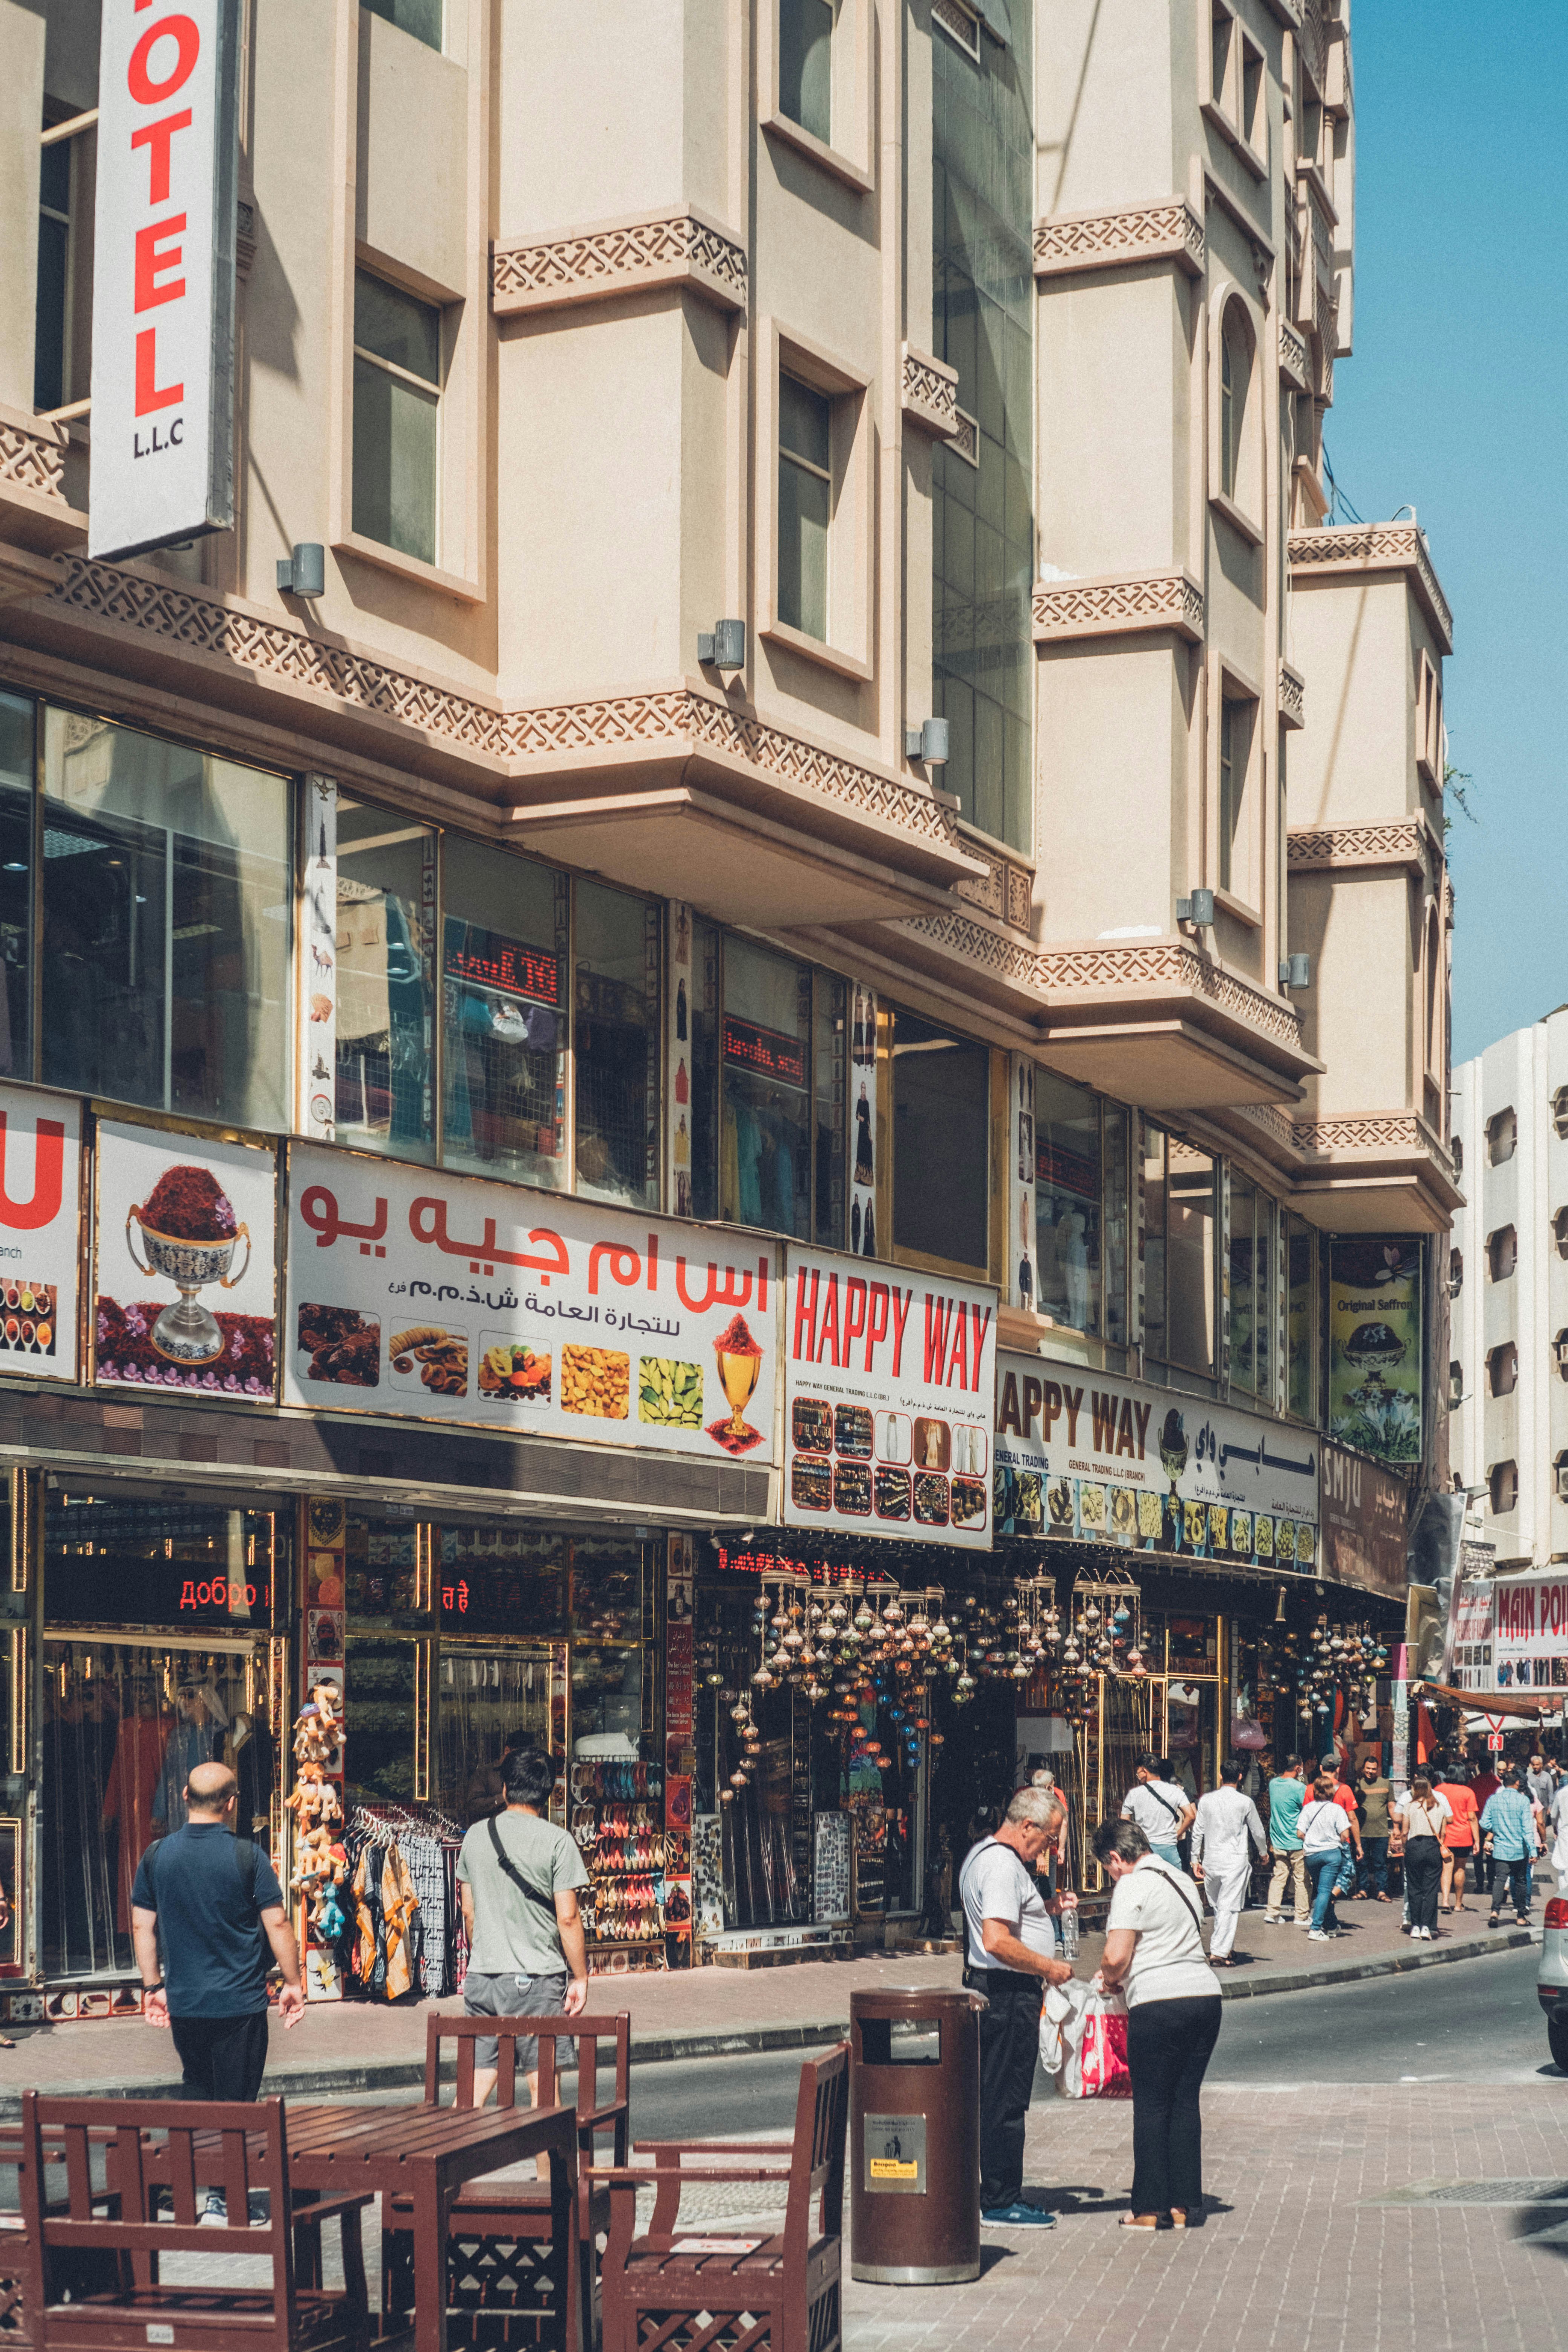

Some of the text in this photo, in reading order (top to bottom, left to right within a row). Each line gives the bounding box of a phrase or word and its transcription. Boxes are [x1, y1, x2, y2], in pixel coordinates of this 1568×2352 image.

[127, 0, 201, 418] OTEL
[133, 418, 184, 460] L.L.C
[388, 1281, 406, 1294] فرع
[525, 1292, 599, 1323] العامة
[1337, 1298, 1413, 1314] Original Saffron
[605, 1308, 680, 1337] للتجارة
[792, 1265, 992, 1393] HAPPY WAY
[795, 1380, 811, 1388] HAPPY
[824, 1384, 845, 1394] GENERAL
[846, 1388, 865, 1397] TRADING
[934, 1404, 947, 1412] العامة
[949, 1407, 965, 1415] للتجارة
[1091, 1390, 1152, 1461] WAY
[994, 1449, 1049, 1470] ENERAL TRADING
[1069, 1459, 1145, 1484] GENERAL TRADING L.L.C (BRANCH)
[180, 1576, 257, 1613] добро
[1499, 1586, 1535, 1644] MAIN
[1540, 1584, 1568, 1642] POI
